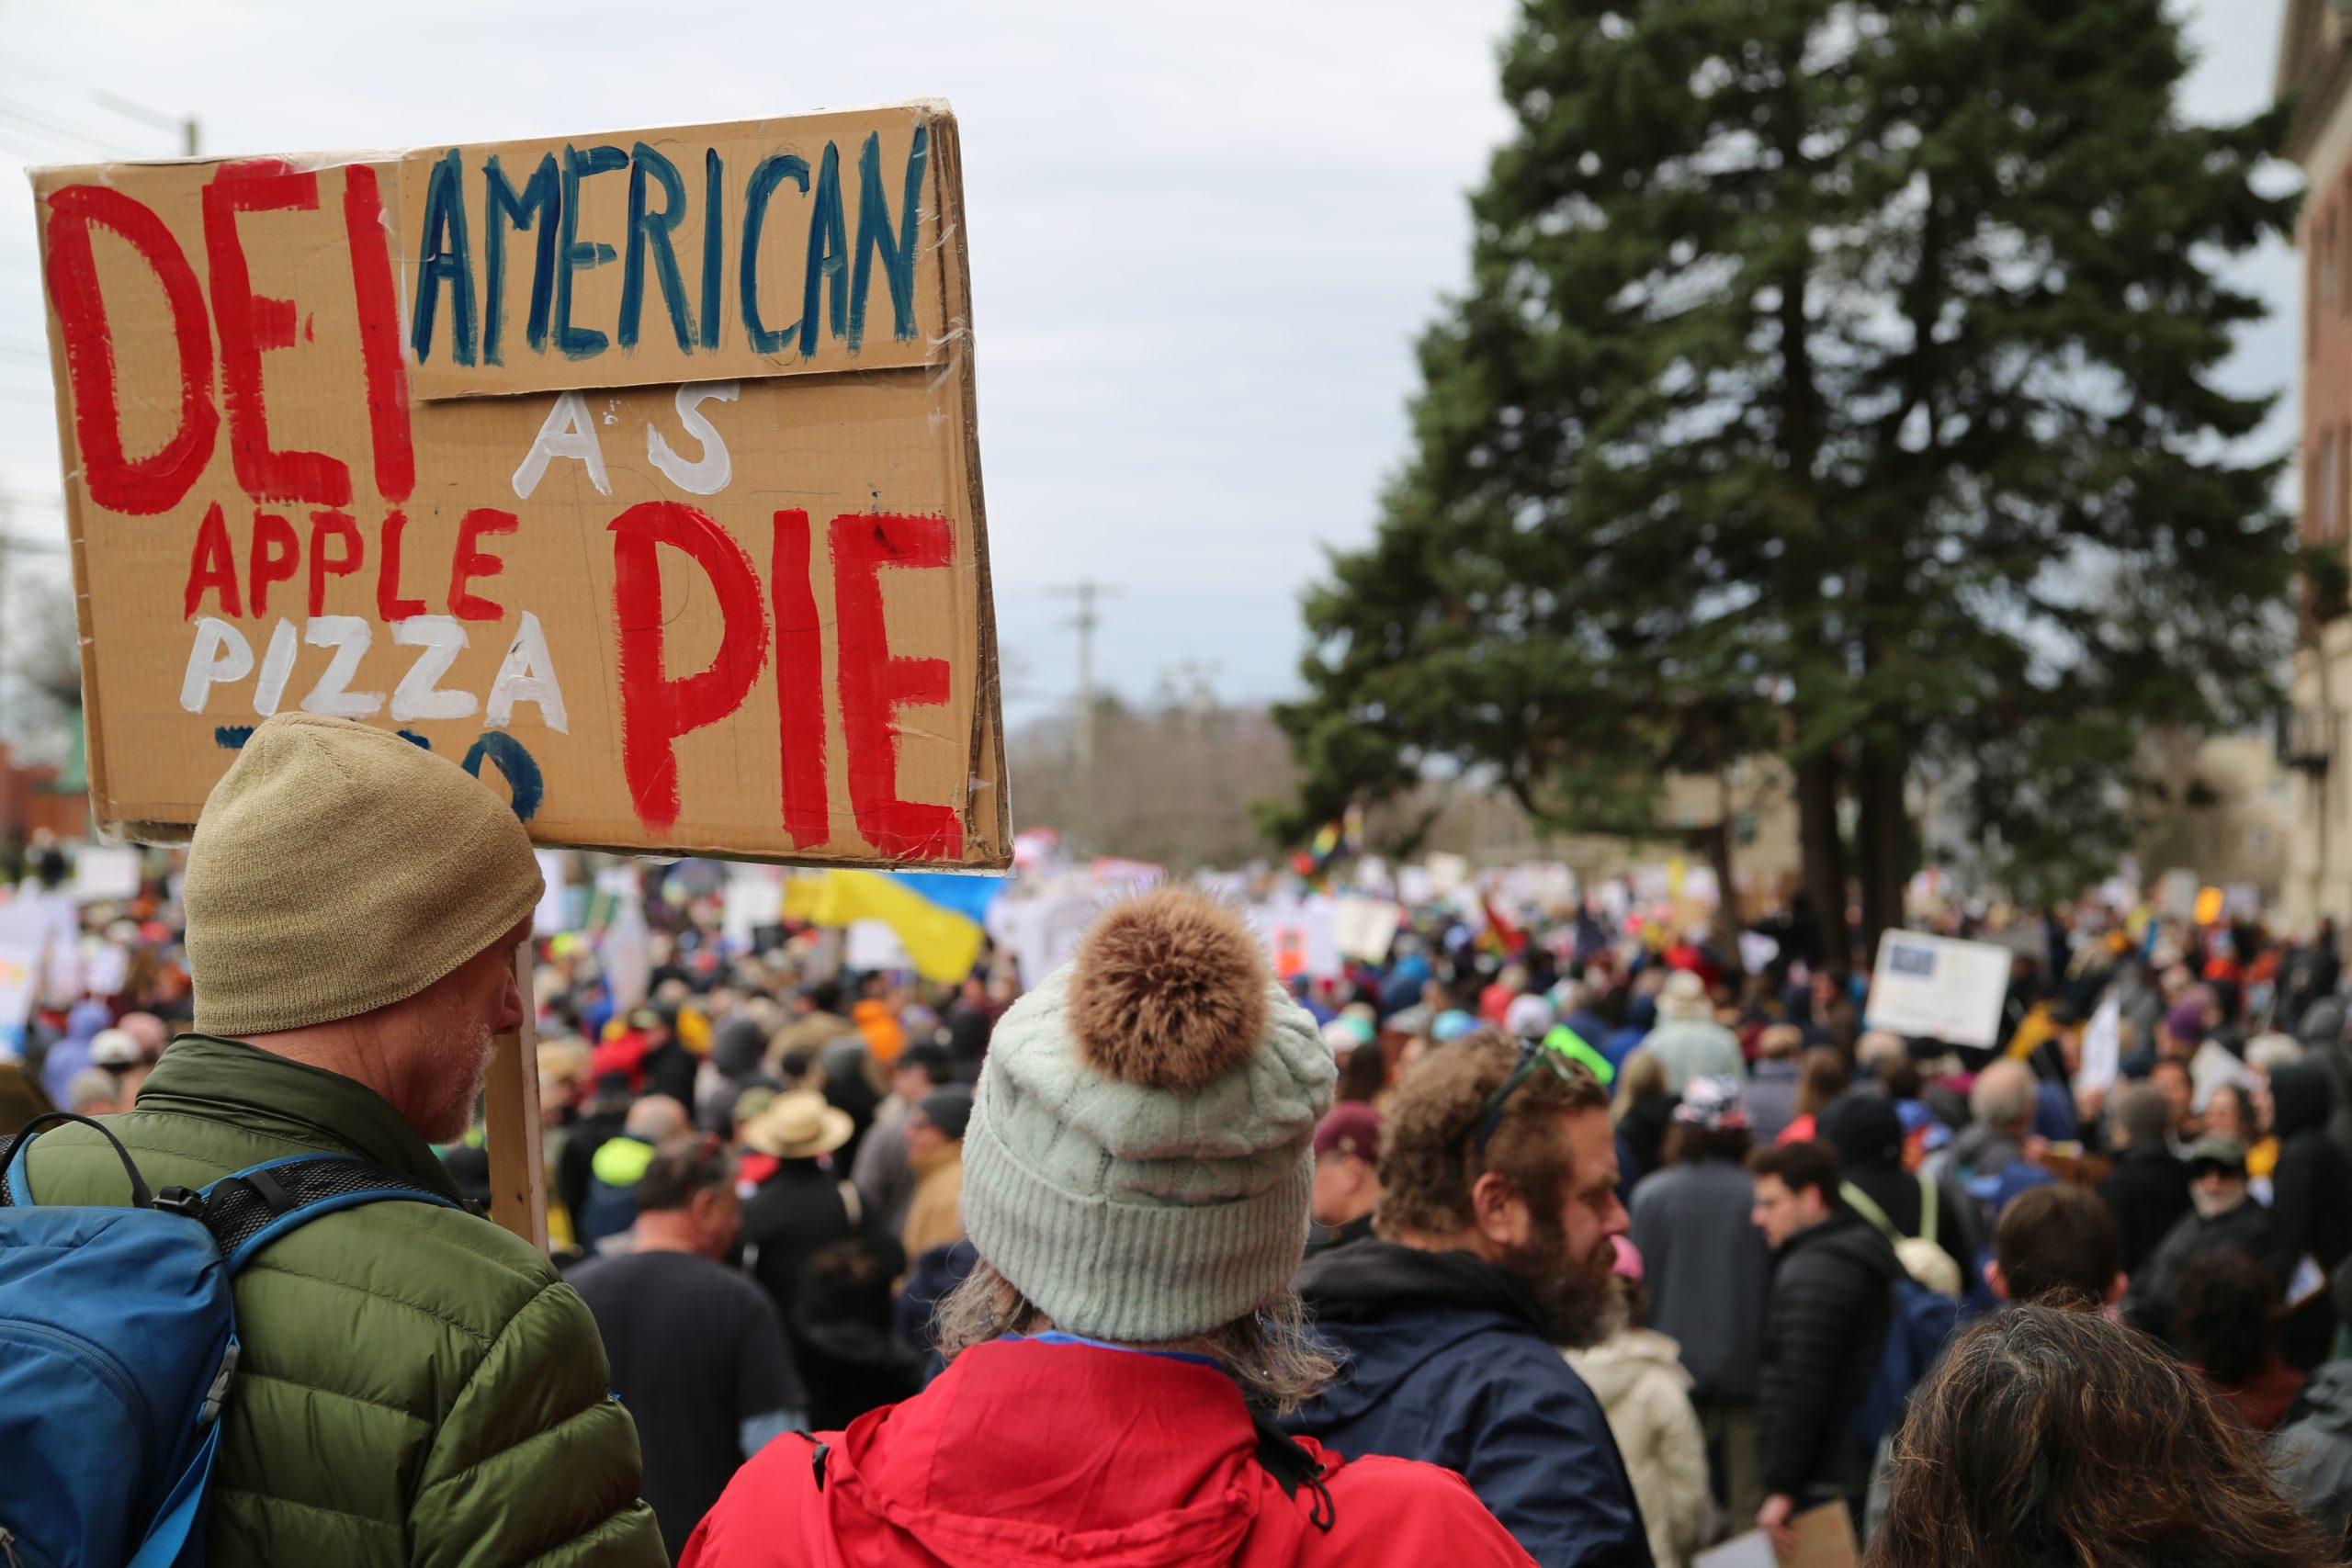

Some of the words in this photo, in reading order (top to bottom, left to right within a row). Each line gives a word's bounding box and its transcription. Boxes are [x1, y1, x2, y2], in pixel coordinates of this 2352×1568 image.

[47, 159, 415, 515] DEI
[411, 125, 928, 368] AMERICAN
[511, 381, 740, 501] AS
[185, 501, 519, 622] APPLE
[180, 610, 569, 735] PIZZA
[605, 500, 964, 862] PIE
